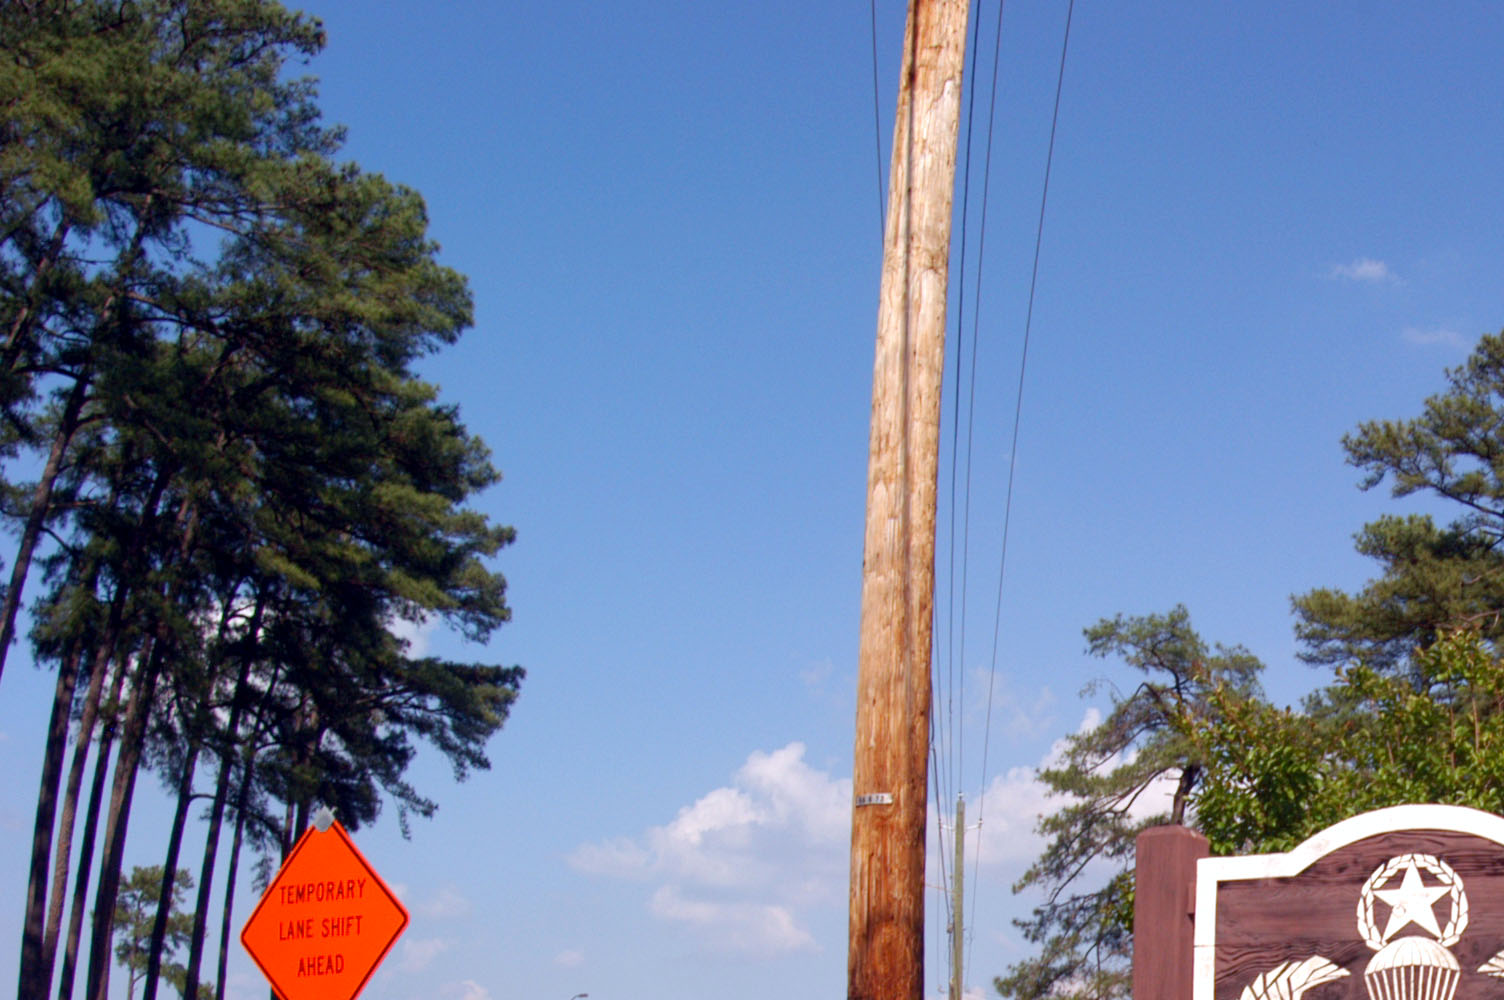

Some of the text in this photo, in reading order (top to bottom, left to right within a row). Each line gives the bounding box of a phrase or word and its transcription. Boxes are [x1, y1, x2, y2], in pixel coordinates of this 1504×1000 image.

[280, 878, 367, 905] TEMPORARY
[279, 915, 363, 941] LANE SHIFT
[297, 953, 345, 977] AHEAD
